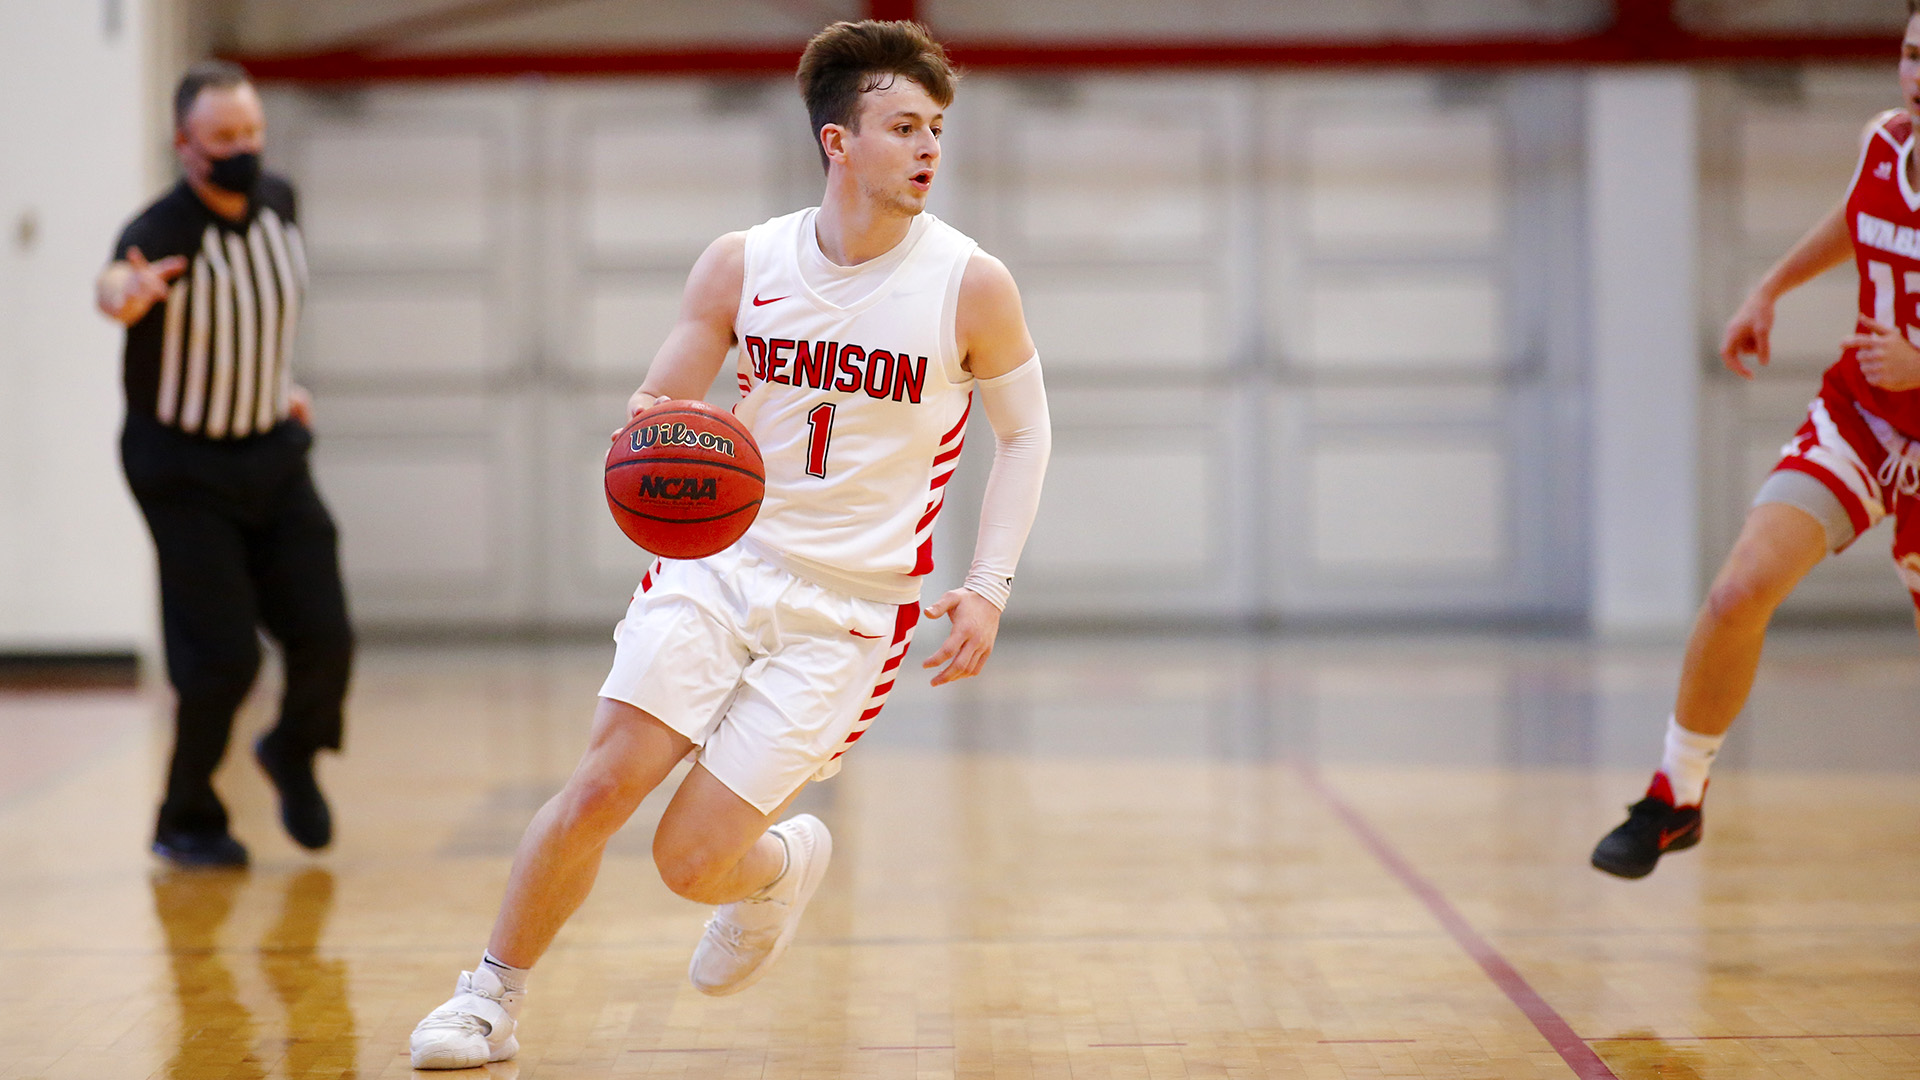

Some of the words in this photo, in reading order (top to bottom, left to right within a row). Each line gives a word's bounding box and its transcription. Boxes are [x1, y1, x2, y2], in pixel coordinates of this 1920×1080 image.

[745, 335, 928, 404] DENISON
[630, 422, 736, 458] Wilson
[806, 402, 836, 479] 1
[638, 475, 717, 501] NCAA
